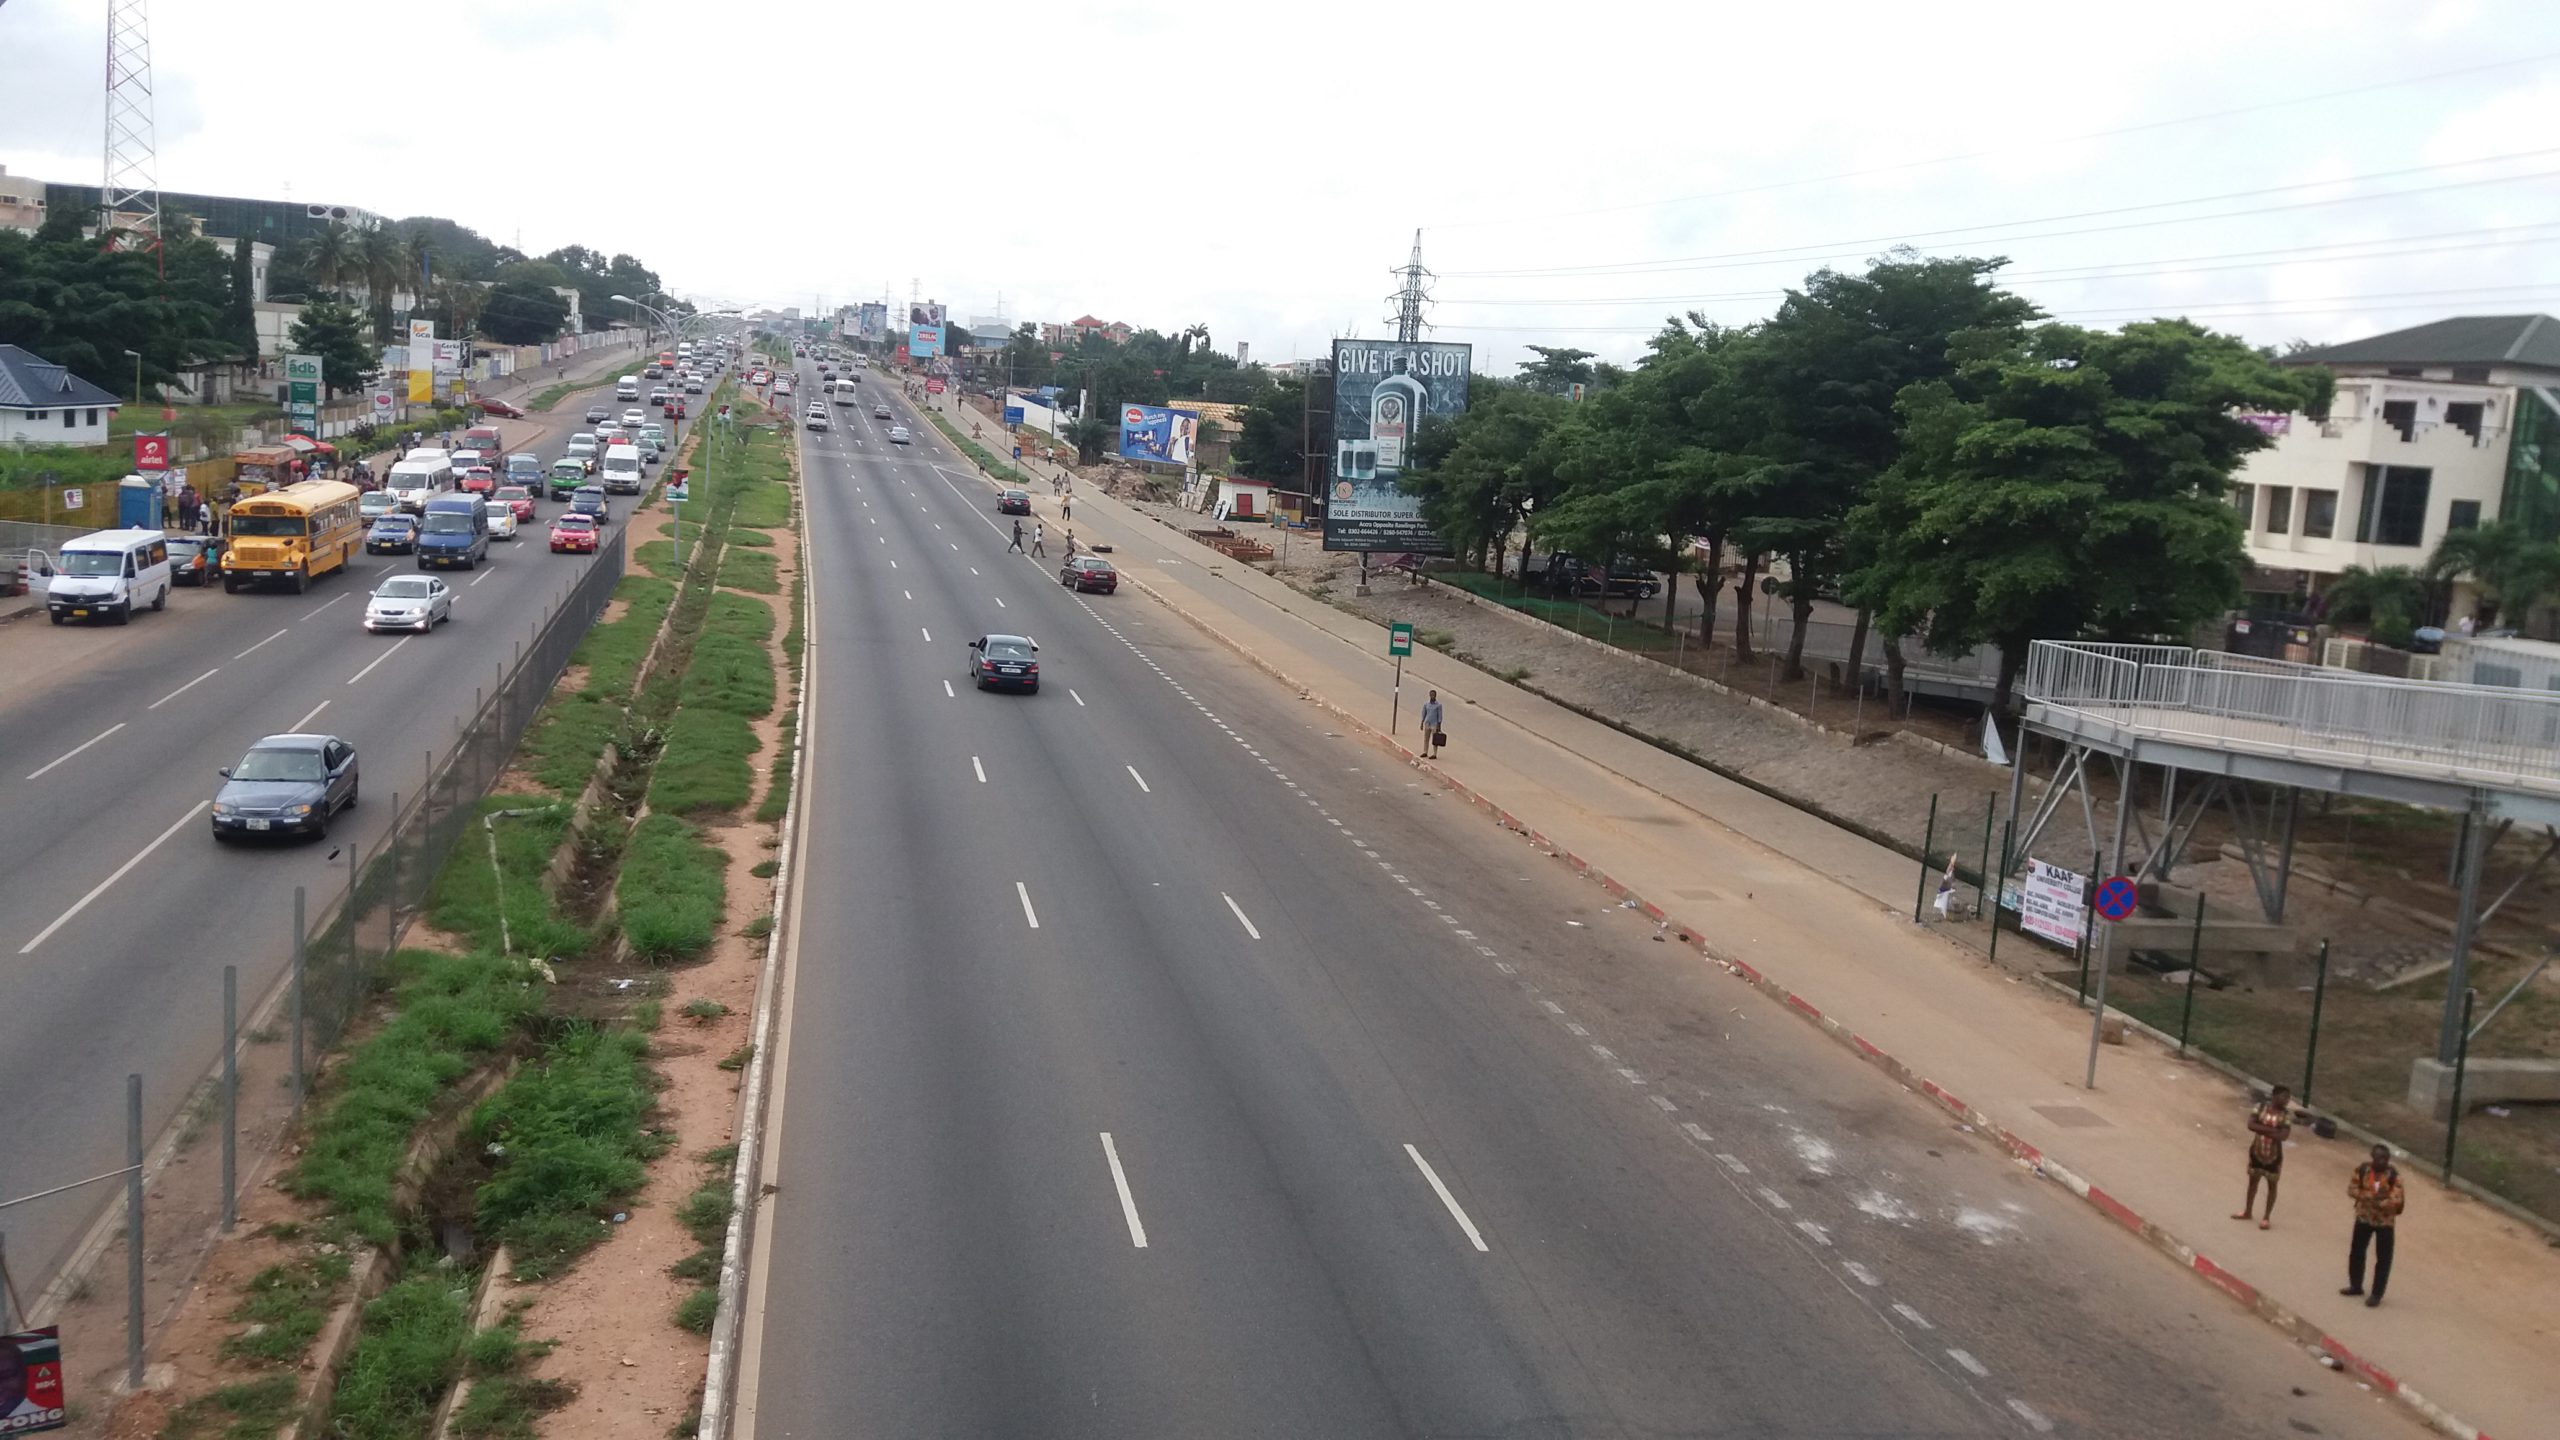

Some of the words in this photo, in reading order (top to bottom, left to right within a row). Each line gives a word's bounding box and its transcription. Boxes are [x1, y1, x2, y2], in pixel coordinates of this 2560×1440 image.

[288, 362, 317, 374] adb
[1338, 348, 1379, 374] GIVE
[1383, 350, 1395, 372] IT
[1407, 350, 1418, 373] A
[1420, 351, 1466, 377] SHOT
[140, 455, 163, 464] airtel
[1333, 509, 1349, 517] SOLE
[1351, 510, 1392, 519] DISTRIBUTOR
[1393, 511, 1414, 519] SUPER
[2046, 865, 2074, 883] KAAF
